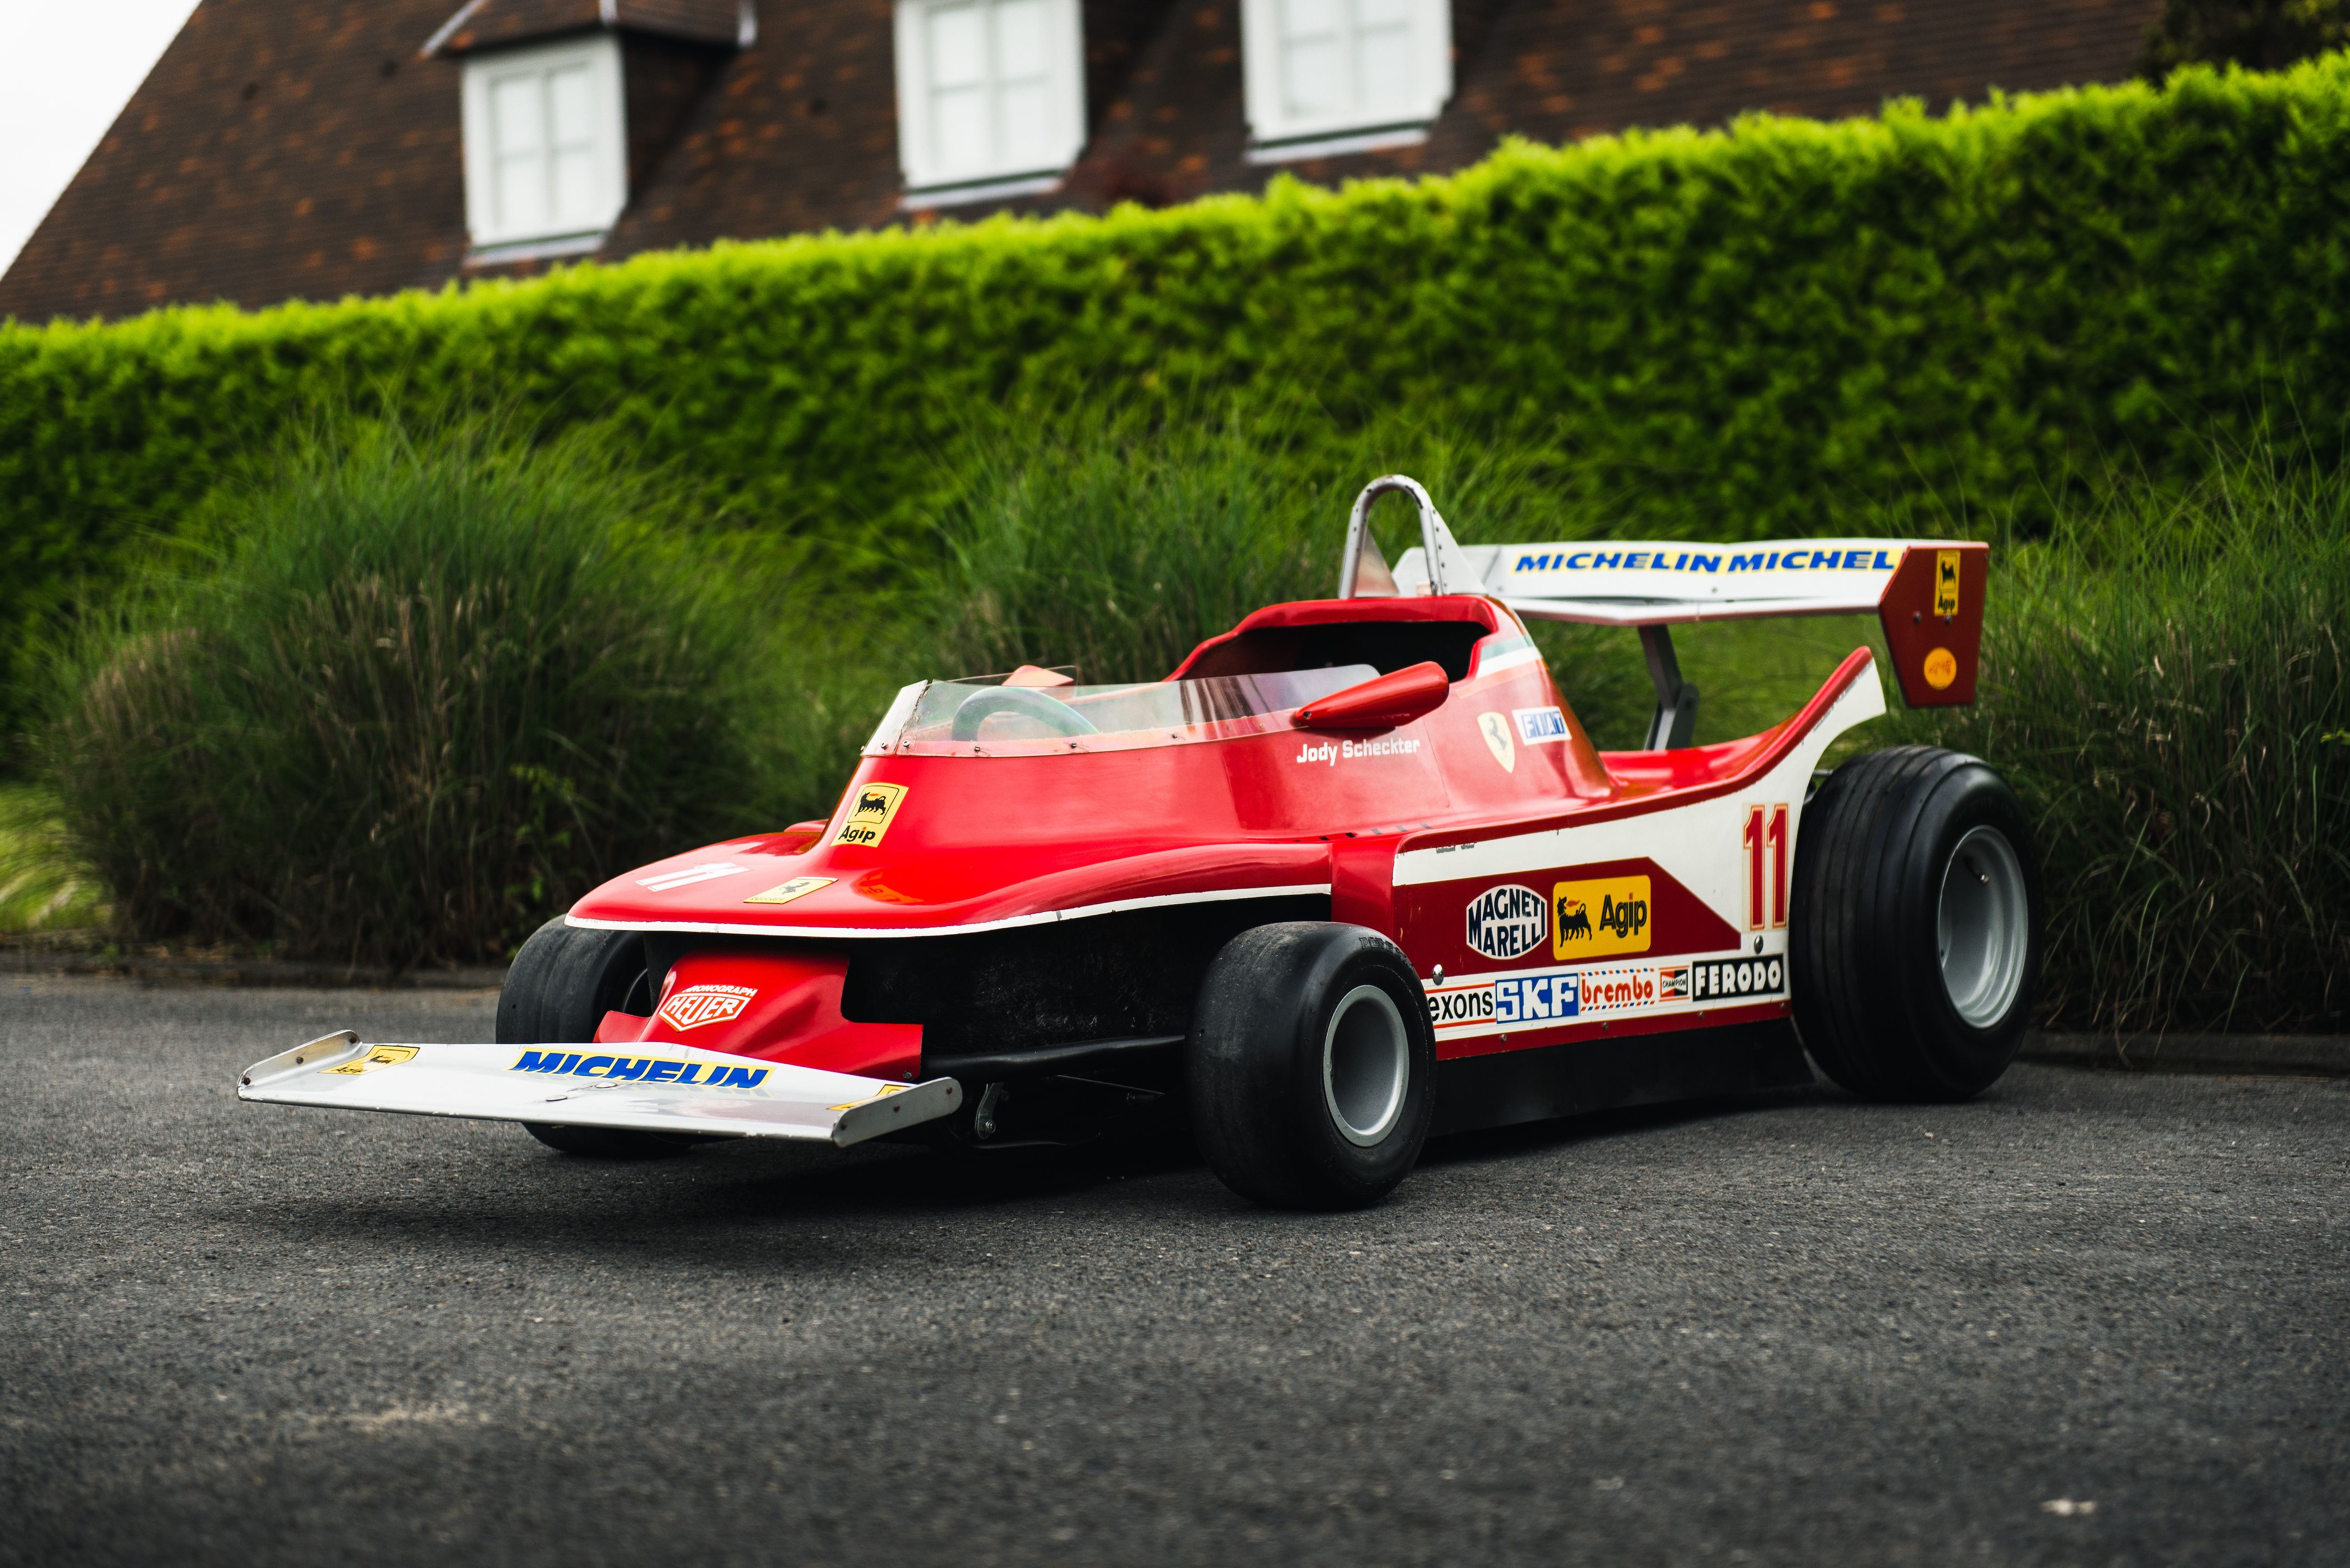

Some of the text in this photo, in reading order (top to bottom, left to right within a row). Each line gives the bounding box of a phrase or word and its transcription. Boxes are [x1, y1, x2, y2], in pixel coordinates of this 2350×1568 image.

[1515, 551, 1905, 572] MICHELIN MICHEL
[1937, 593, 1955, 614] Agip
[1522, 712, 1565, 739] FIAT
[1296, 737, 1420, 767] Jody Scheckter
[838, 825, 876, 843] Agip
[1742, 803, 1789, 932] 11
[1468, 888, 1545, 924] MAGNETI
[1599, 892, 1647, 938] Agip
[1468, 924, 1545, 957] MARELLI
[681, 985, 758, 997] RONOGRAPH
[1582, 975, 1654, 1004] brembo
[1662, 978, 1687, 988] CHAMPION
[1695, 959, 1782, 997] FERODO
[666, 996, 740, 1025] HEUER
[1496, 977, 1578, 1021] SKF
[510, 1051, 769, 1088] MICHELIN
